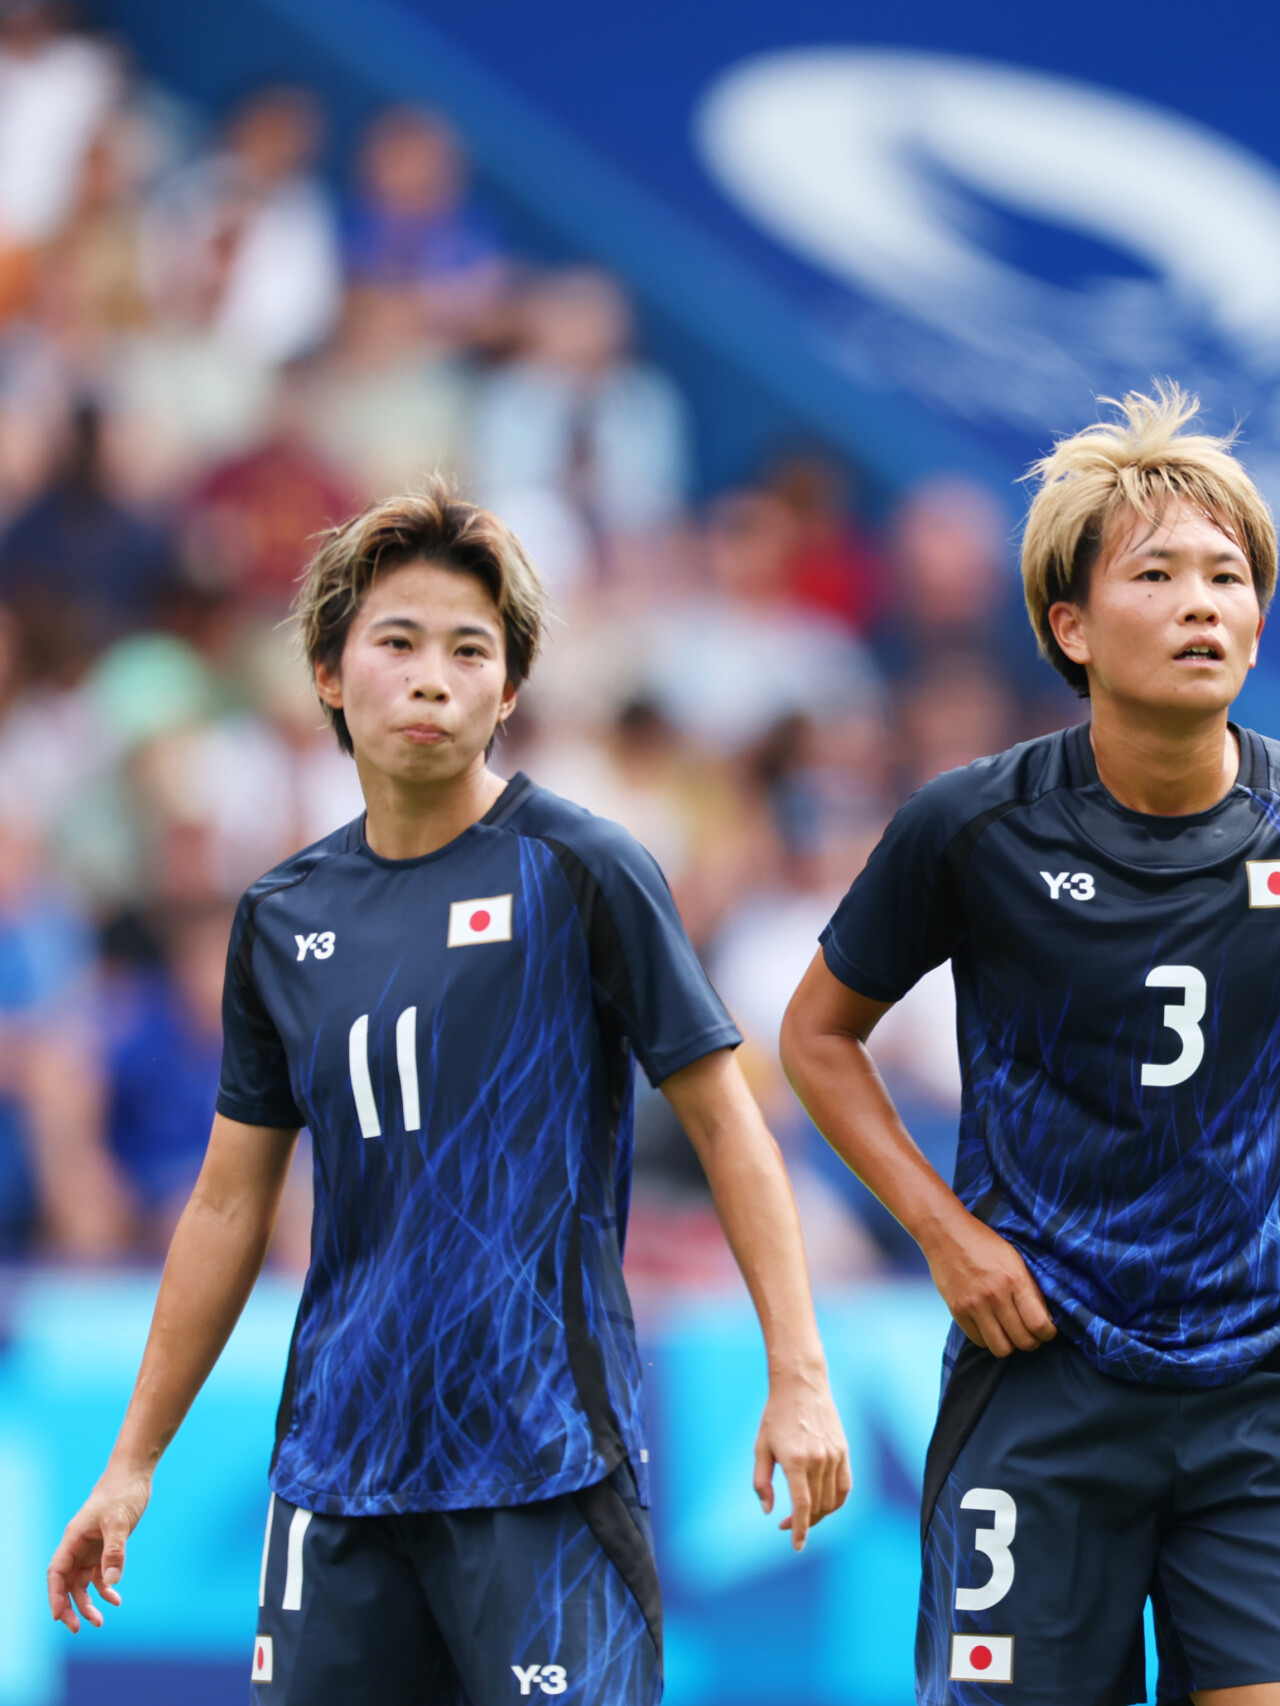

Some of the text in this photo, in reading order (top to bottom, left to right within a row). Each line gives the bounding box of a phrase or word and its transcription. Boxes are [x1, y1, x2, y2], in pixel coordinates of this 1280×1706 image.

[1039, 871, 1096, 901] Y-3
[294, 930, 336, 963] Y-3
[1140, 965, 1207, 1087] 3
[348, 1005, 421, 1139] 11
[954, 1487, 1017, 1611] 3
[511, 1664, 568, 1695] Y-3
